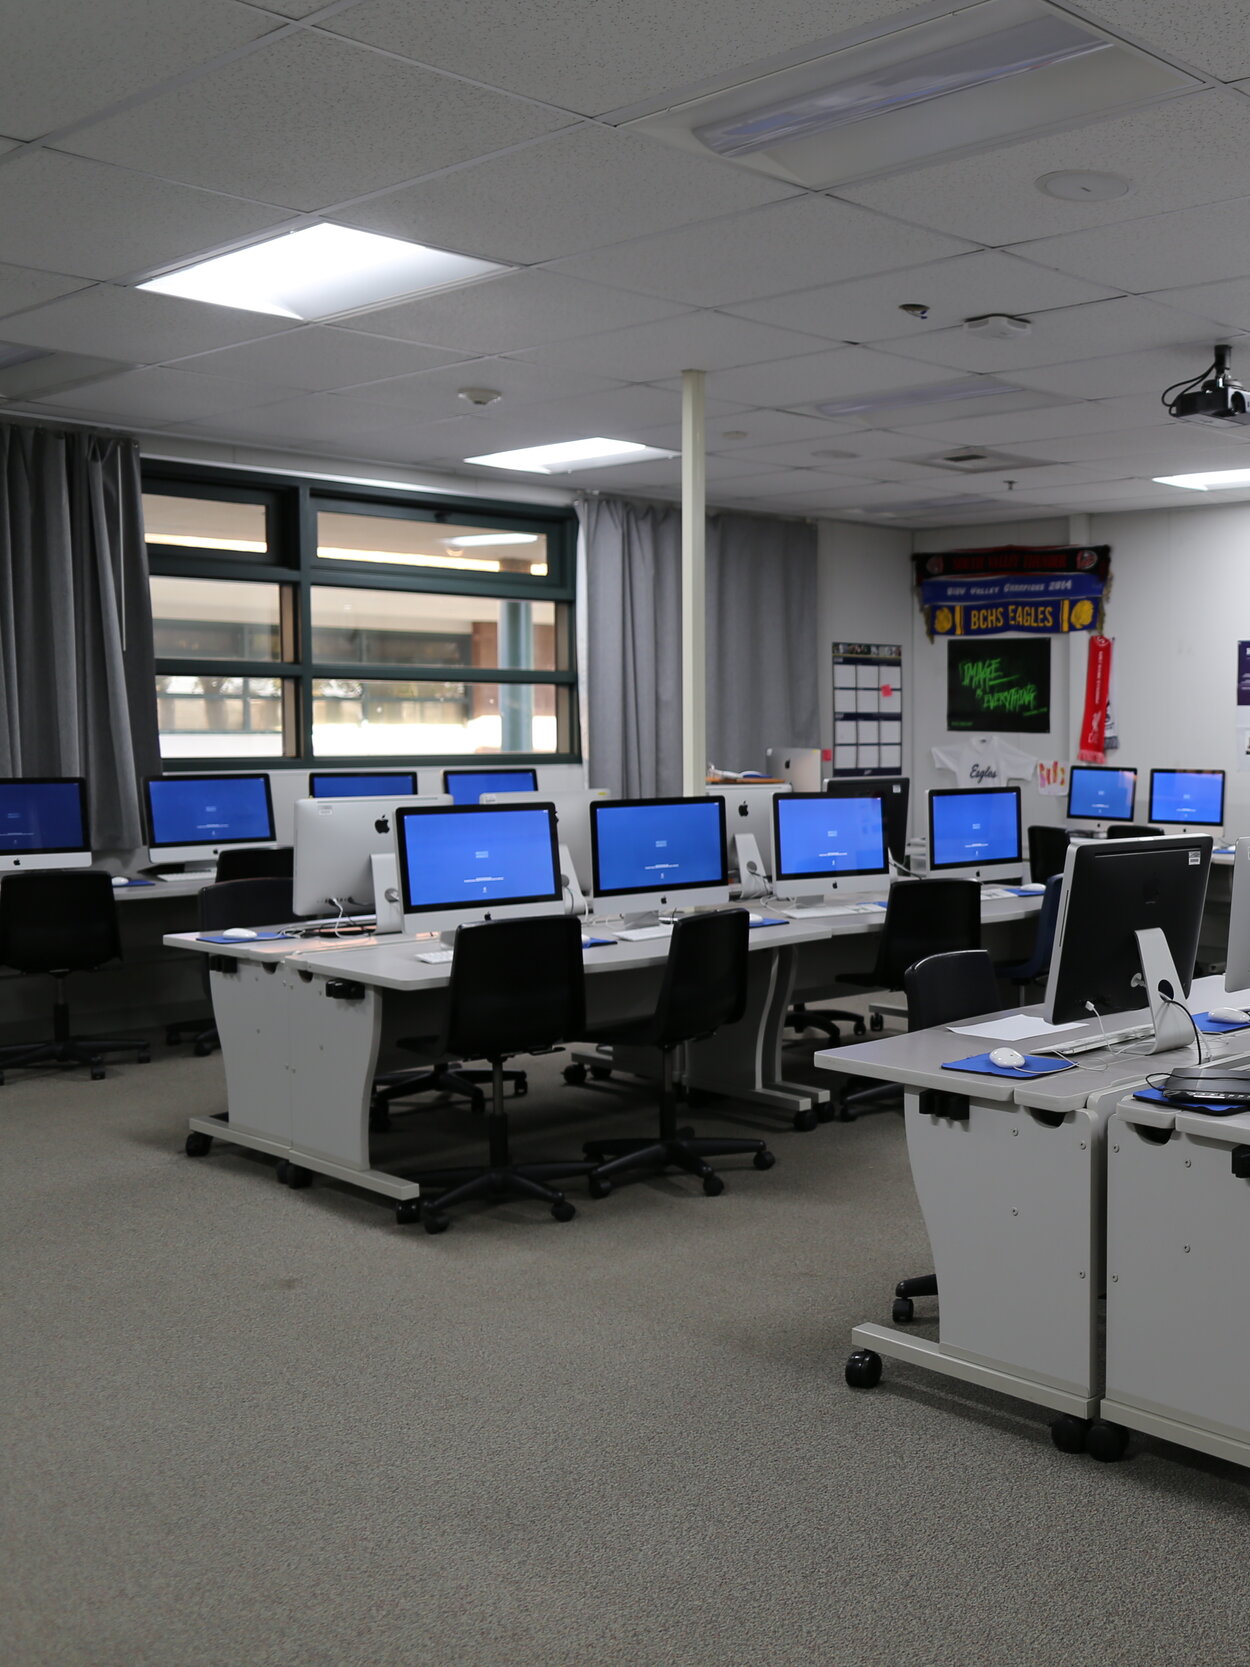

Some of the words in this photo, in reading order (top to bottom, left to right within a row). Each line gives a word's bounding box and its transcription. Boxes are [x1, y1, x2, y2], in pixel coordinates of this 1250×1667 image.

[970, 609, 1004, 629] BCHS
[1008, 605, 1053, 627] EAGLES
[960, 658, 1003, 690] IMAGE
[969, 763, 999, 784] Eagles
